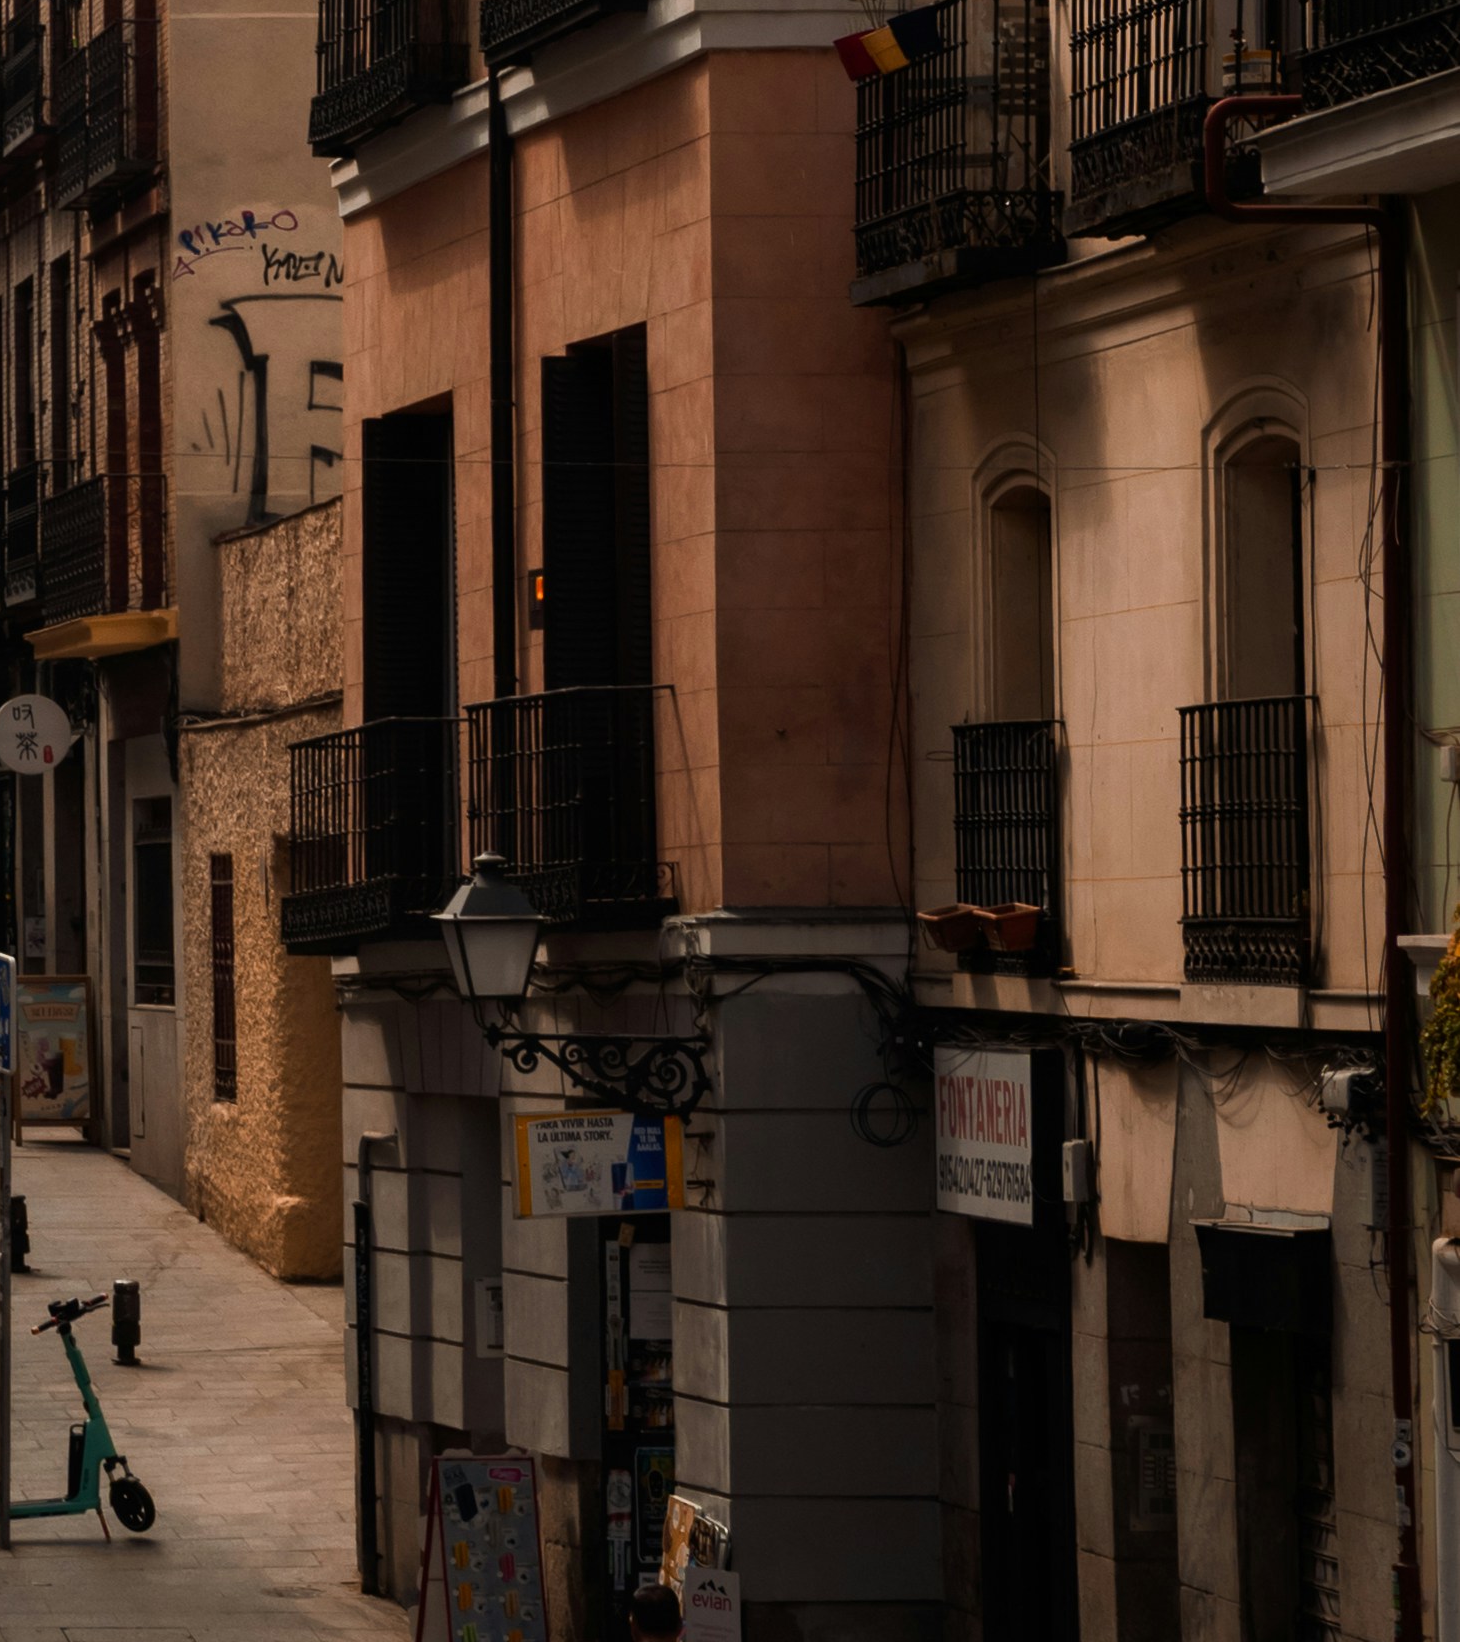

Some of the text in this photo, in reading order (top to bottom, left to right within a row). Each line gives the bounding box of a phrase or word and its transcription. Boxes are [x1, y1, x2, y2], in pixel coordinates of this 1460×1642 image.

[939, 1075, 1028, 1148] FONTANERIA
[560, 1119, 584, 1129] VIVIR
[587, 1117, 614, 1128] HASTA
[537, 1129, 613, 1143] LA ÚLTIMA STORY.
[691, 1593, 732, 1612] evian
